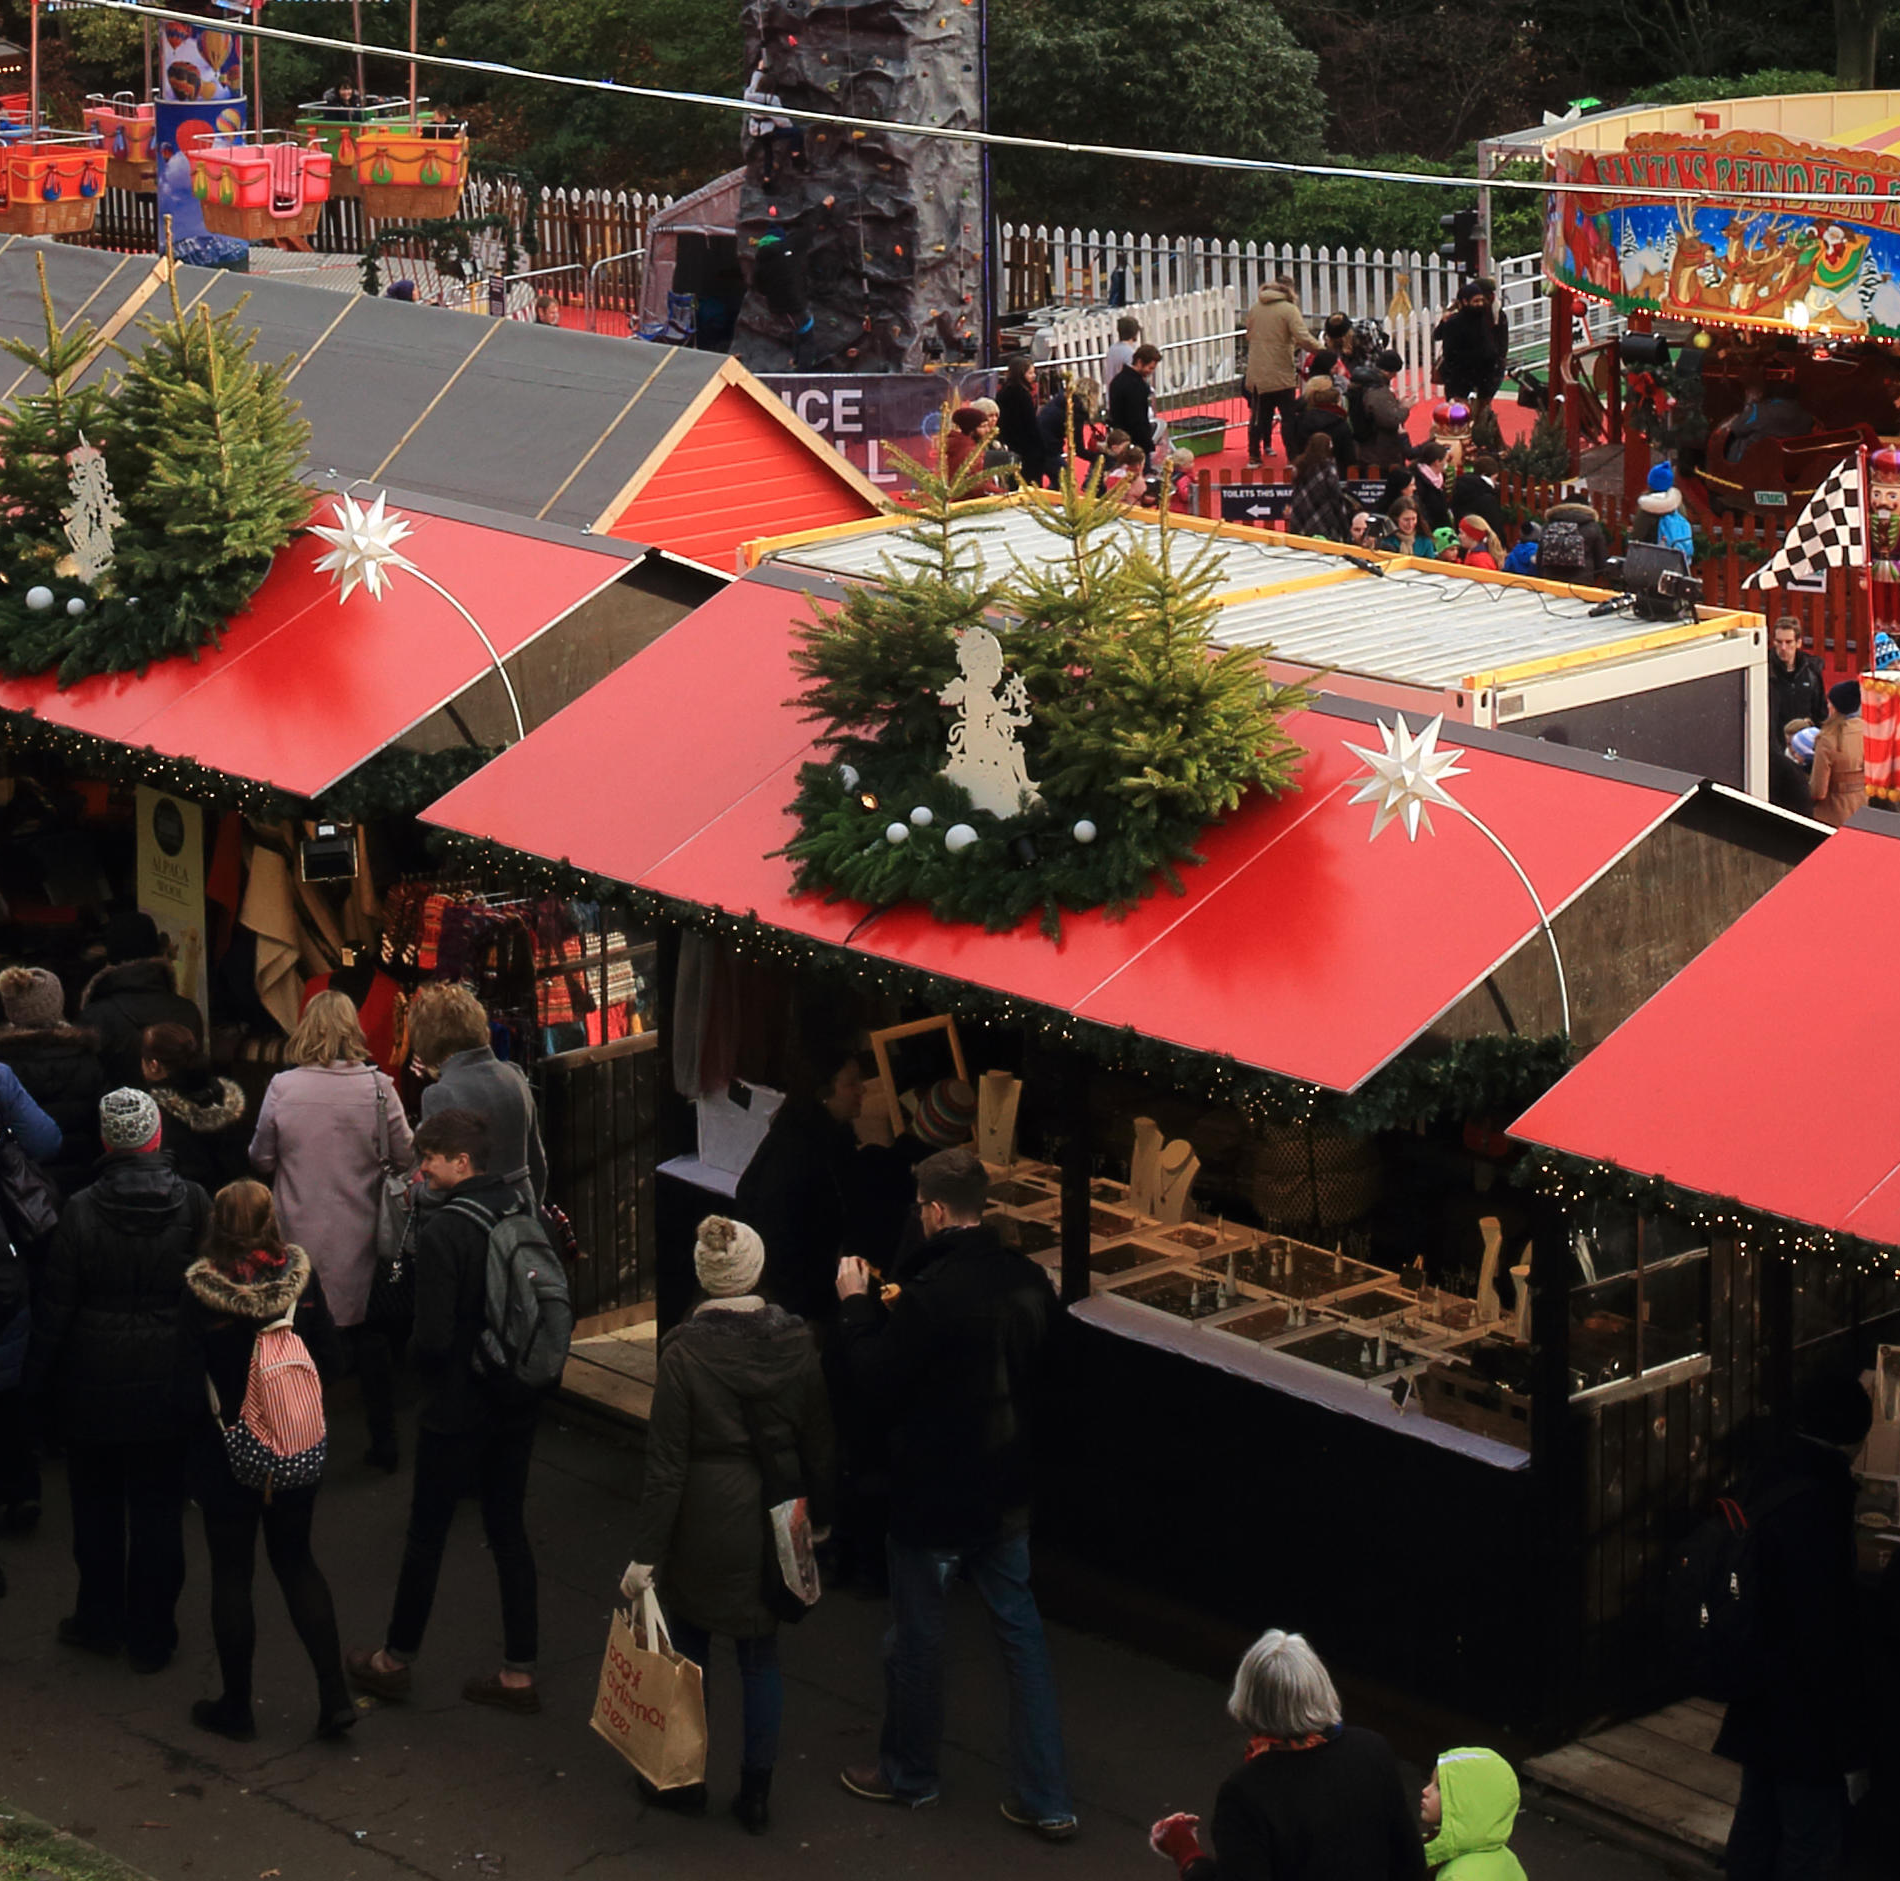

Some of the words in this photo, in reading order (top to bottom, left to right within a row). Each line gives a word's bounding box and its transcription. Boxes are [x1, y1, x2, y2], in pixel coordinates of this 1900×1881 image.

[1598, 155, 1707, 206] SANTA'S
[1714, 158, 1878, 219] REINDEER
[1222, 489, 1255, 499] TOILETS
[1256, 489, 1275, 499] THIS
[1276, 489, 1293, 498] WAY
[152, 856, 189, 882] ALPACA
